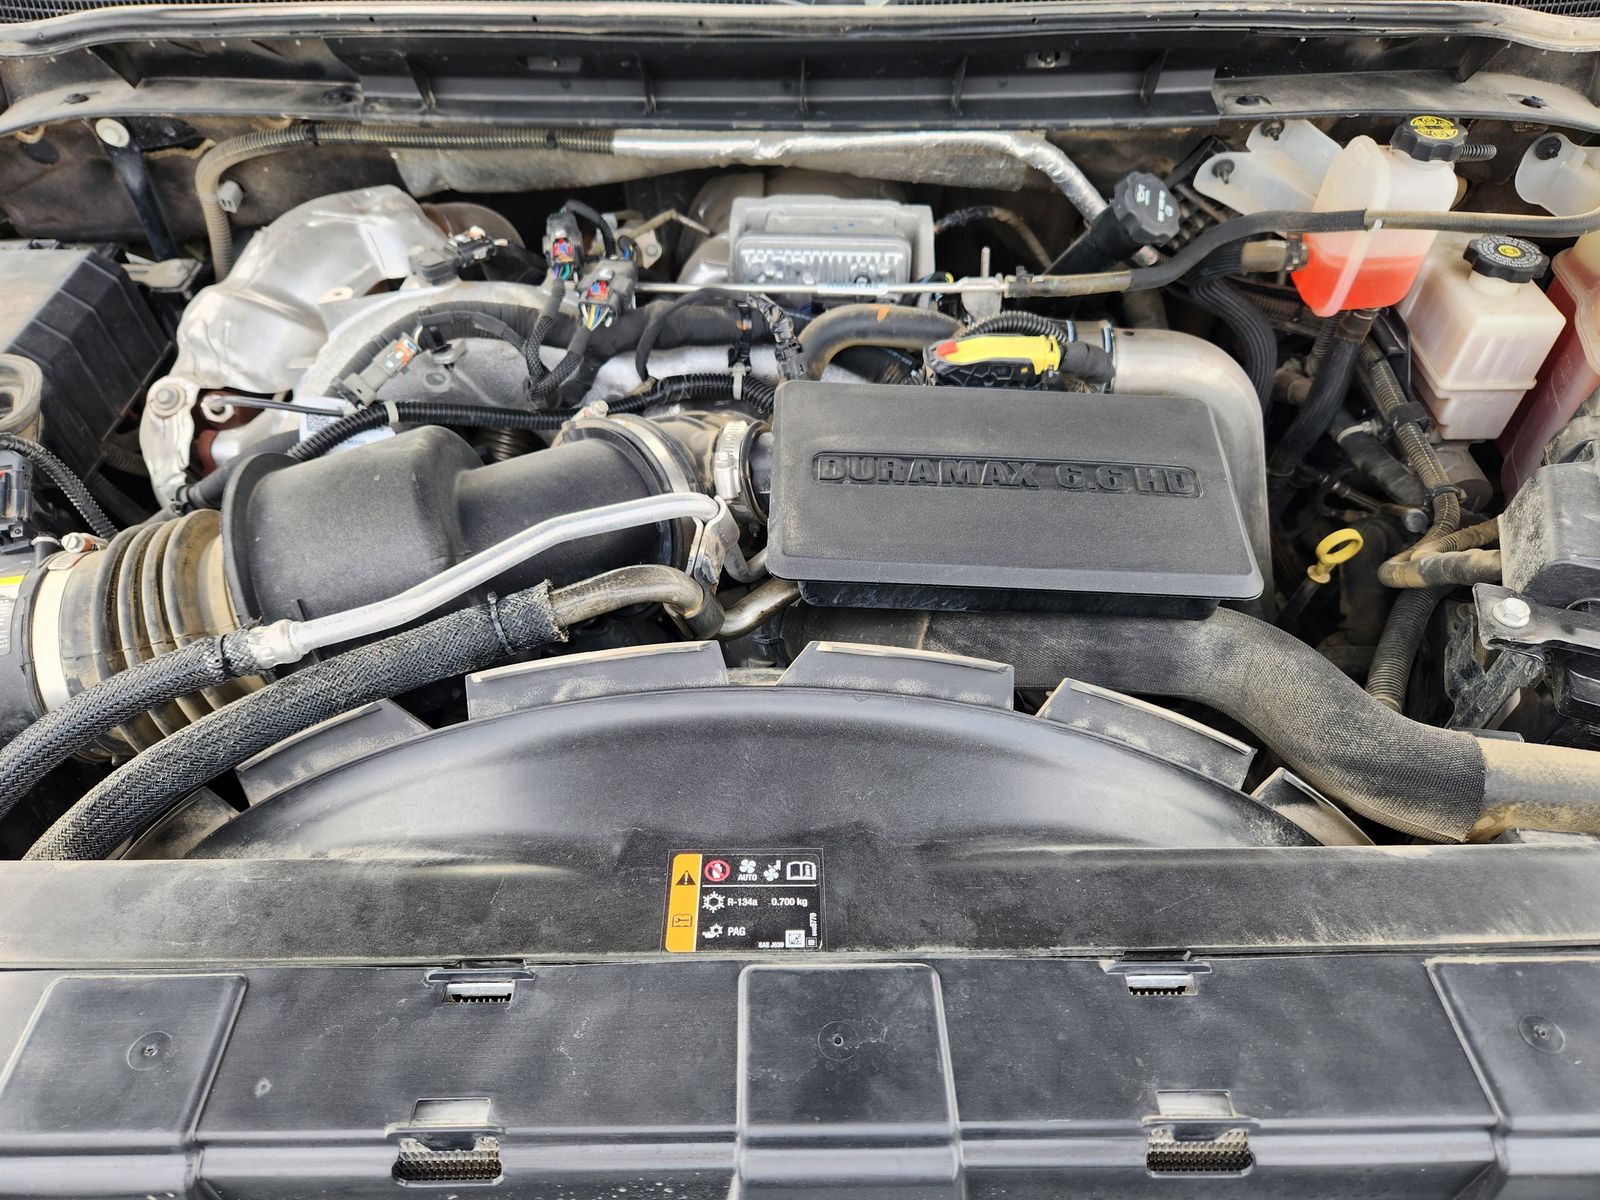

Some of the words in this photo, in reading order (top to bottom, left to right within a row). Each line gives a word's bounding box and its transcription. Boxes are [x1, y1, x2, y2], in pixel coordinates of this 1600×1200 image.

[816, 454, 1039, 490] DURAMAX
[1055, 461, 1126, 492] 6.6
[1133, 465, 1196, 495] HD
[727, 898, 758, 906] R-134a
[771, 898, 795, 906] 0.700
[797, 898, 808, 907] kg
[728, 927, 746, 936] PAG
